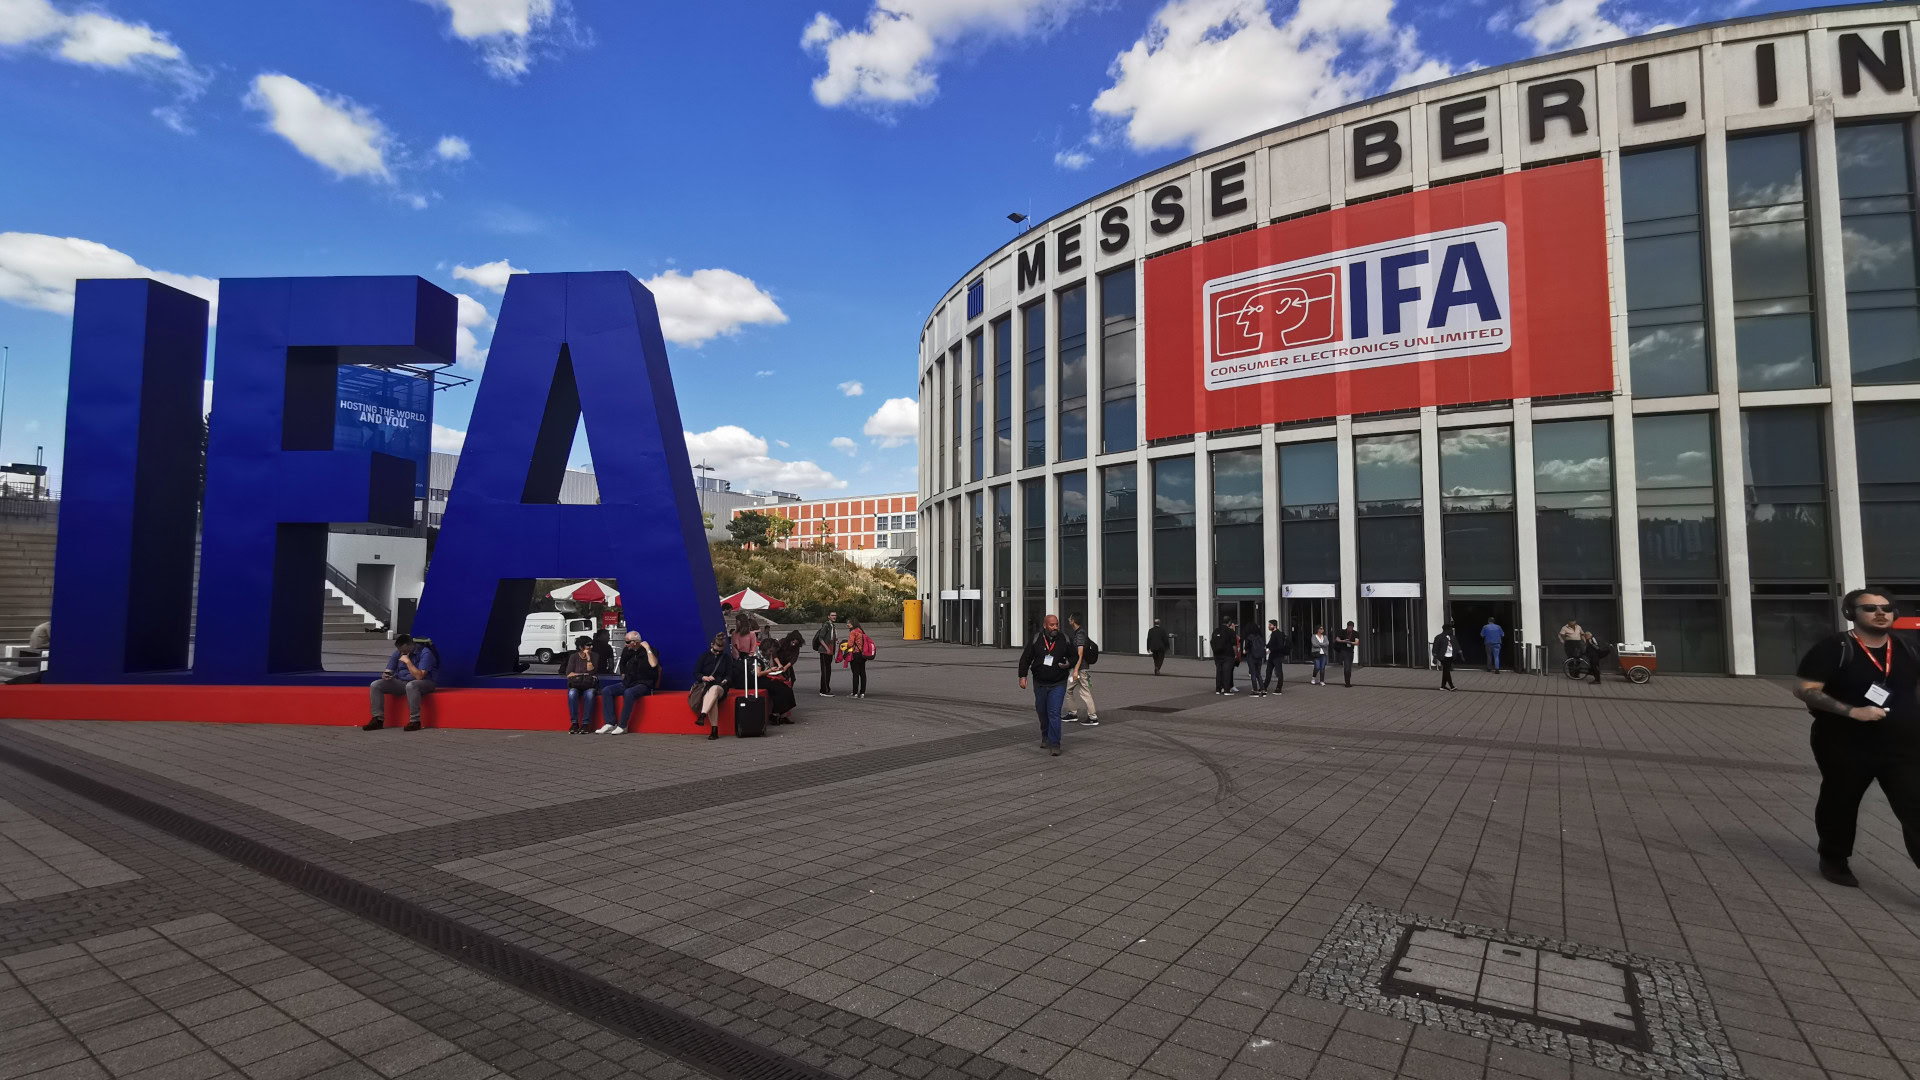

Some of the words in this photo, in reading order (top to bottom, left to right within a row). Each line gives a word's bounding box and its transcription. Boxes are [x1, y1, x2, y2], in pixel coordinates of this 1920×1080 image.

[1018, 161, 1247, 291] MESSE
[1353, 30, 1906, 181] BERLIN
[1349, 241, 1502, 340] IFA
[1210, 356, 1289, 377] CONSUMER
[1293, 340, 1399, 363] ELECTRONICS
[1404, 327, 1503, 348] UNLIMITED
[340, 400, 377, 414] HOSTING
[379, 406, 395, 417] THE
[396, 409, 427, 422] WORLD.
[360, 411, 382, 424] AND
[385, 416, 409, 429] YOU.
[48, 270, 723, 688] IFA
